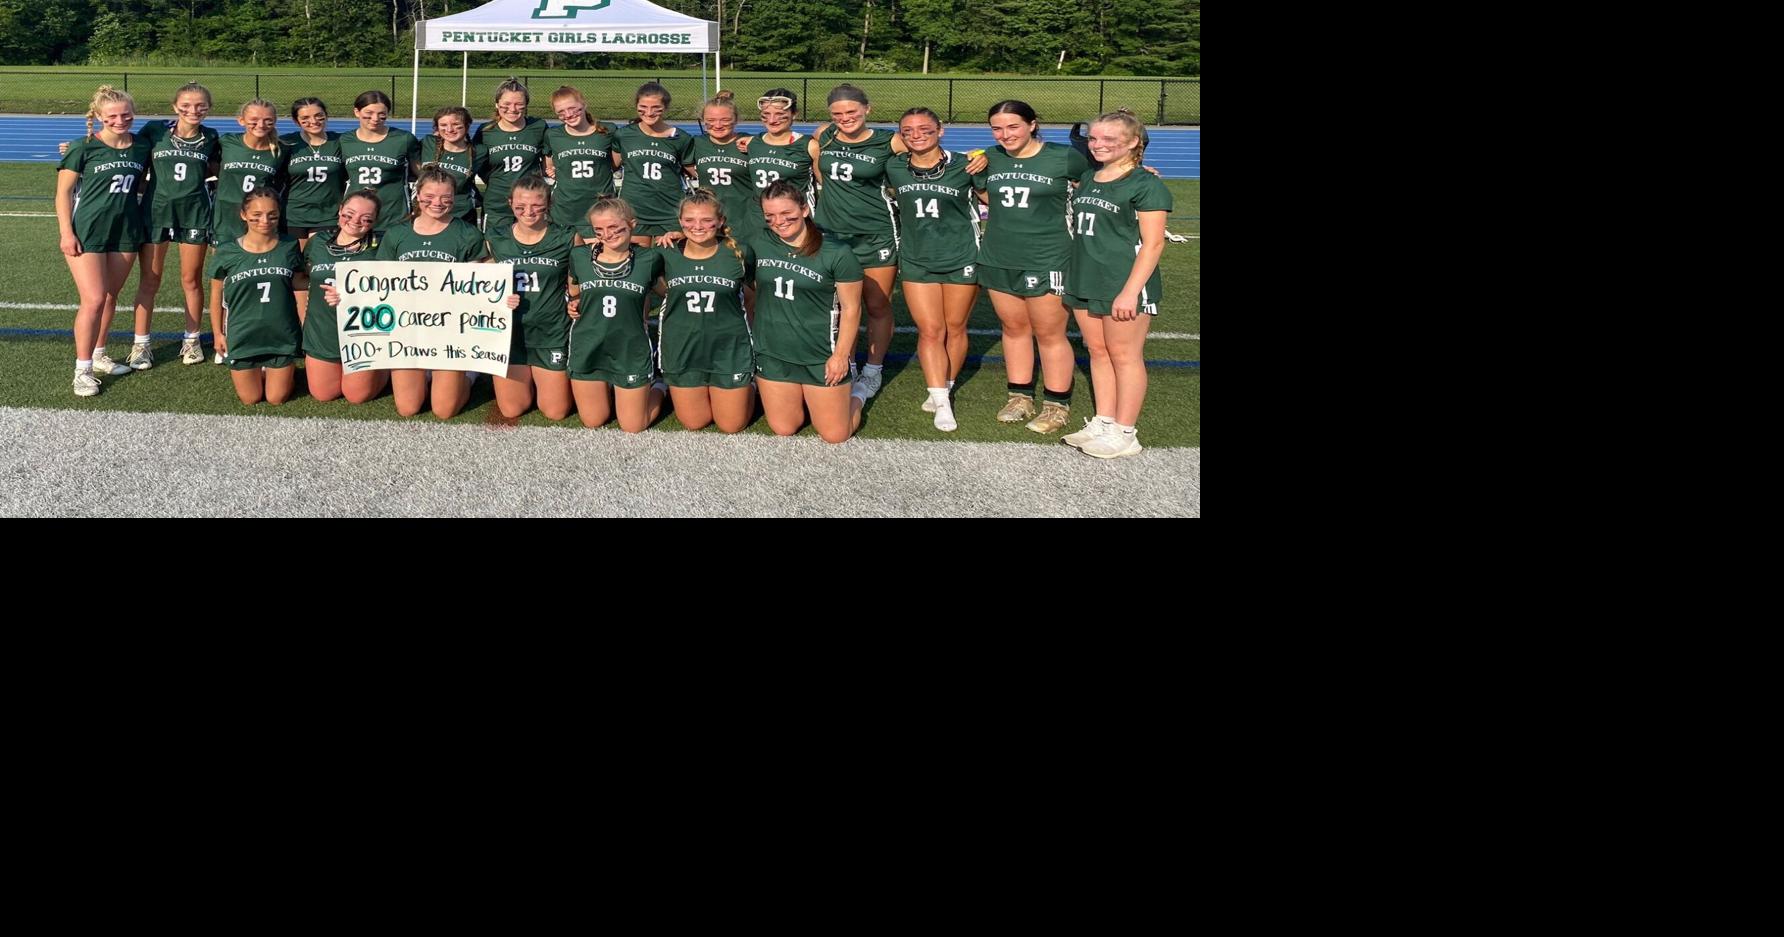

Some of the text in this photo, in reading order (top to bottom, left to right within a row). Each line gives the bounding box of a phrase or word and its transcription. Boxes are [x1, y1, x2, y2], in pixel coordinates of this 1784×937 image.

[442, 31, 691, 45] PENTUCKET GIRLS LACROSSE
[345, 155, 399, 166] PENTUCKET
[503, 156, 523, 172] 18
[571, 161, 594, 178] 25
[749, 157, 799, 170] ENTUCKET
[174, 163, 187, 181] 9
[307, 167, 328, 183] 15
[358, 167, 382, 184] 23
[642, 162, 662, 180] 16
[707, 168, 732, 186] 35
[830, 162, 853, 182] 13
[987, 172, 1053, 185] PENTUCKET
[108, 174, 135, 193] 20
[242, 175, 256, 193] 6
[898, 183, 960, 198] PENTUCKET
[999, 186, 1030, 209] 37
[914, 198, 939, 218] 14
[1077, 212, 1095, 236] 17
[190, 229, 199, 238] P
[398, 250, 457, 263] PENTUCKET
[879, 249, 890, 260] P
[757, 258, 824, 283] PENTUCKET
[344, 269, 507, 303] Congrats Audrey
[515, 271, 541, 292] 21
[579, 279, 645, 294] PENTUCKET
[667, 275, 736, 289] PENTUCKET
[773, 276, 795, 301] 11
[1026, 276, 1038, 288] P
[257, 281, 271, 303] 7
[602, 295, 617, 318] 8
[685, 291, 716, 313] 27
[344, 304, 395, 332] 200
[460, 310, 507, 333] points
[341, 341, 507, 365] 100+ Draws this Season
[551, 352, 562, 363] P
